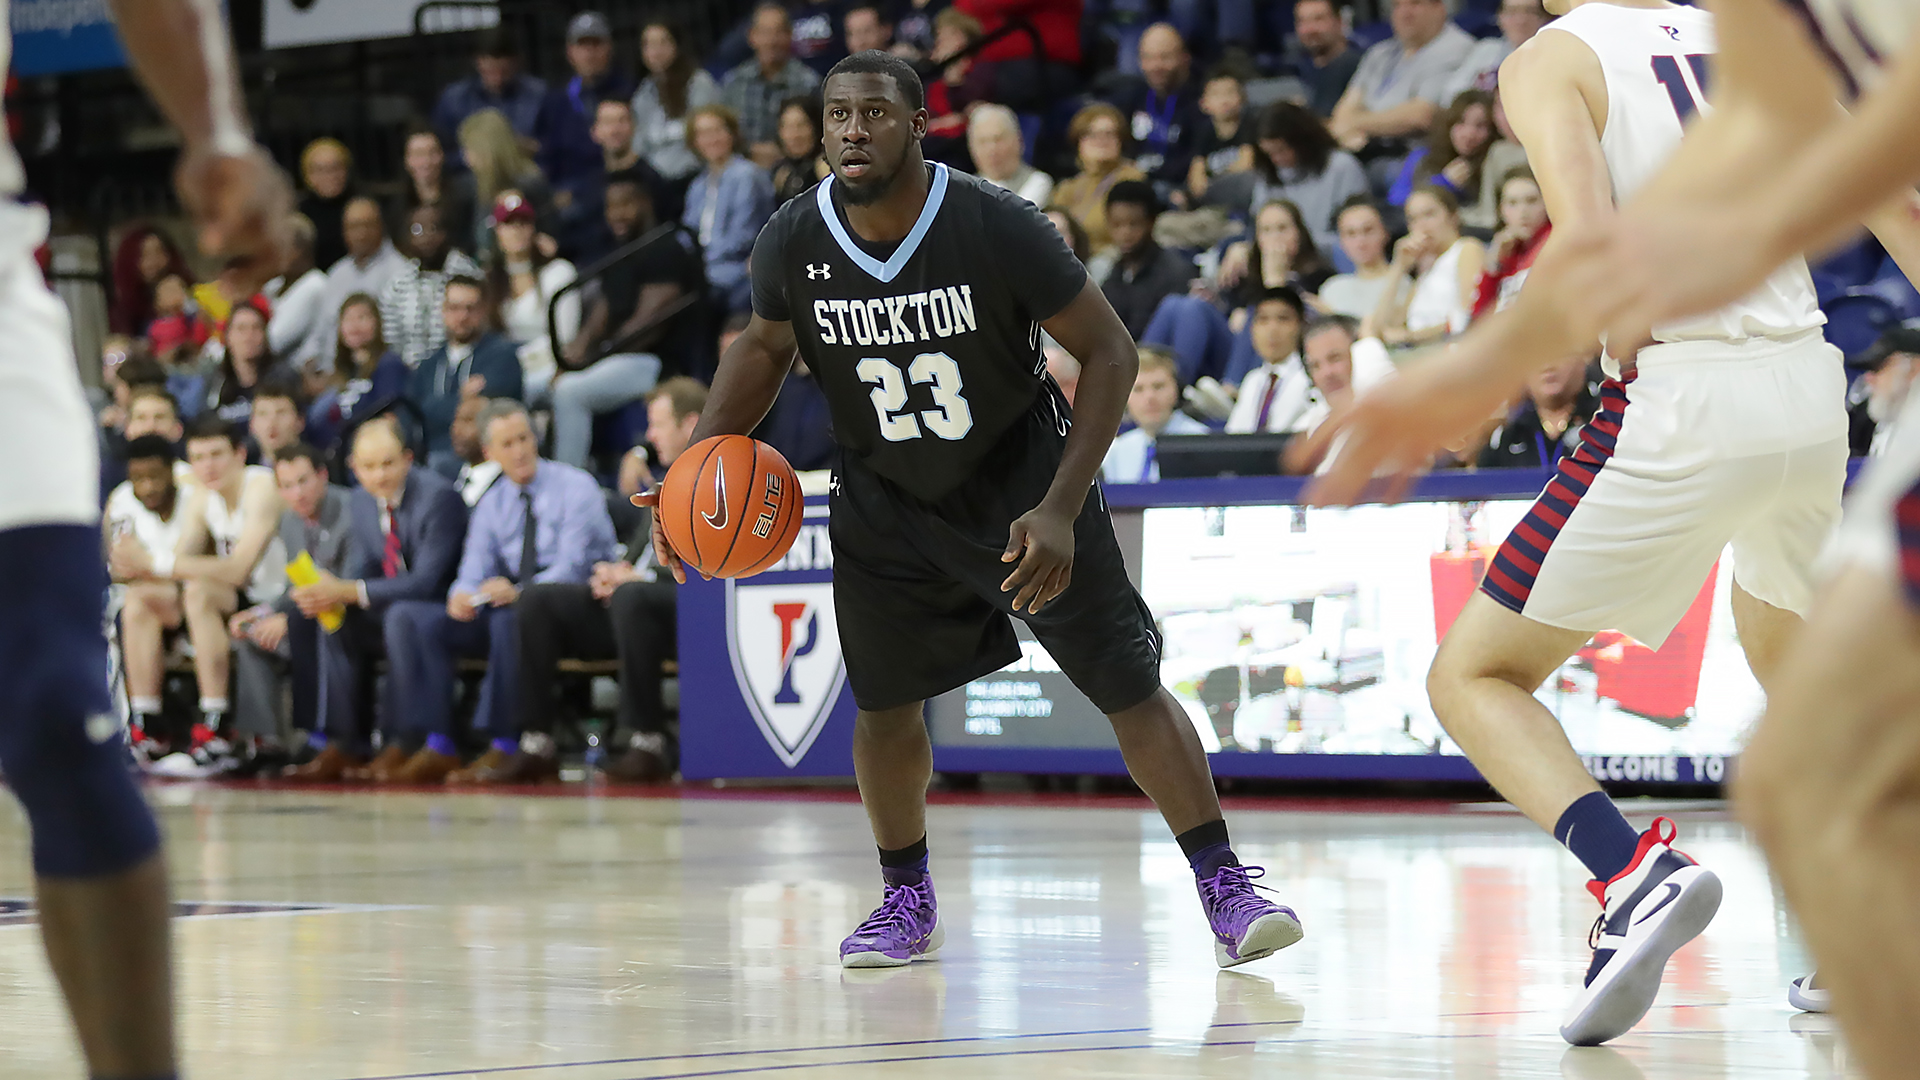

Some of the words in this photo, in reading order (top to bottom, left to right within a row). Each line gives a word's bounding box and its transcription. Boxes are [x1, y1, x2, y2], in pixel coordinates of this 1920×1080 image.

[813, 284, 978, 346] STOCKTON
[855, 351, 974, 442] 23
[752, 472, 782, 539] ELITE
[1581, 756, 1679, 782] ELCOME
[1690, 756, 1725, 782] TO
